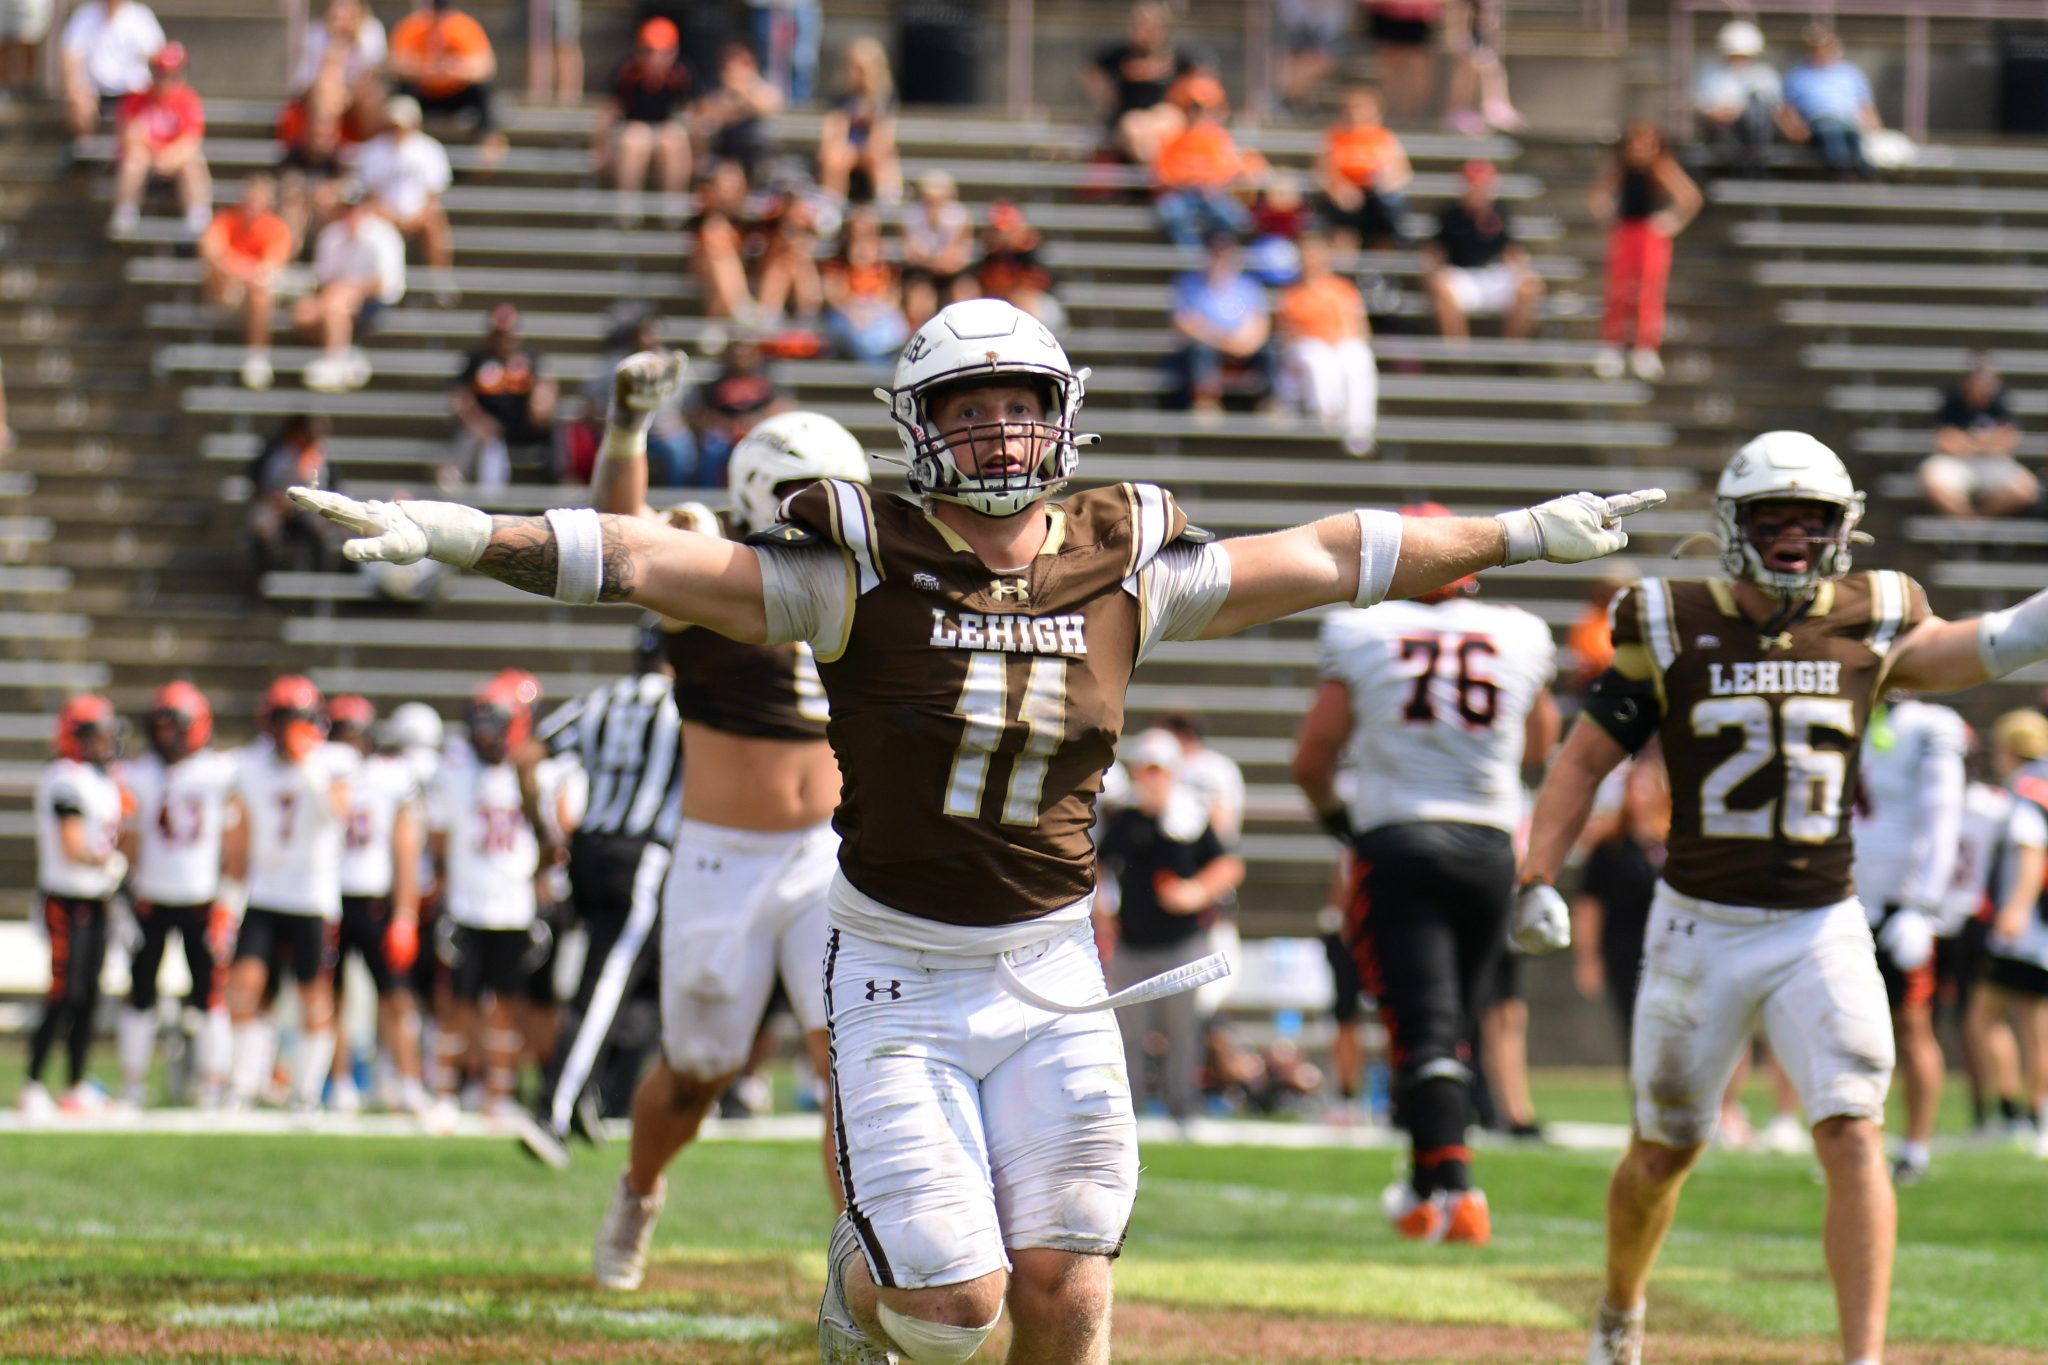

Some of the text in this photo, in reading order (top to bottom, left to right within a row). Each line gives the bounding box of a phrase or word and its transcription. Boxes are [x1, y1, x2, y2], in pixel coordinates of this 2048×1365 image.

[930, 608, 1088, 654] LEHIGH
[1709, 661, 1840, 695] LEHIGH
[1398, 632, 1497, 727] 76
[943, 652, 1067, 827] 11
[1691, 696, 1856, 844] 26
